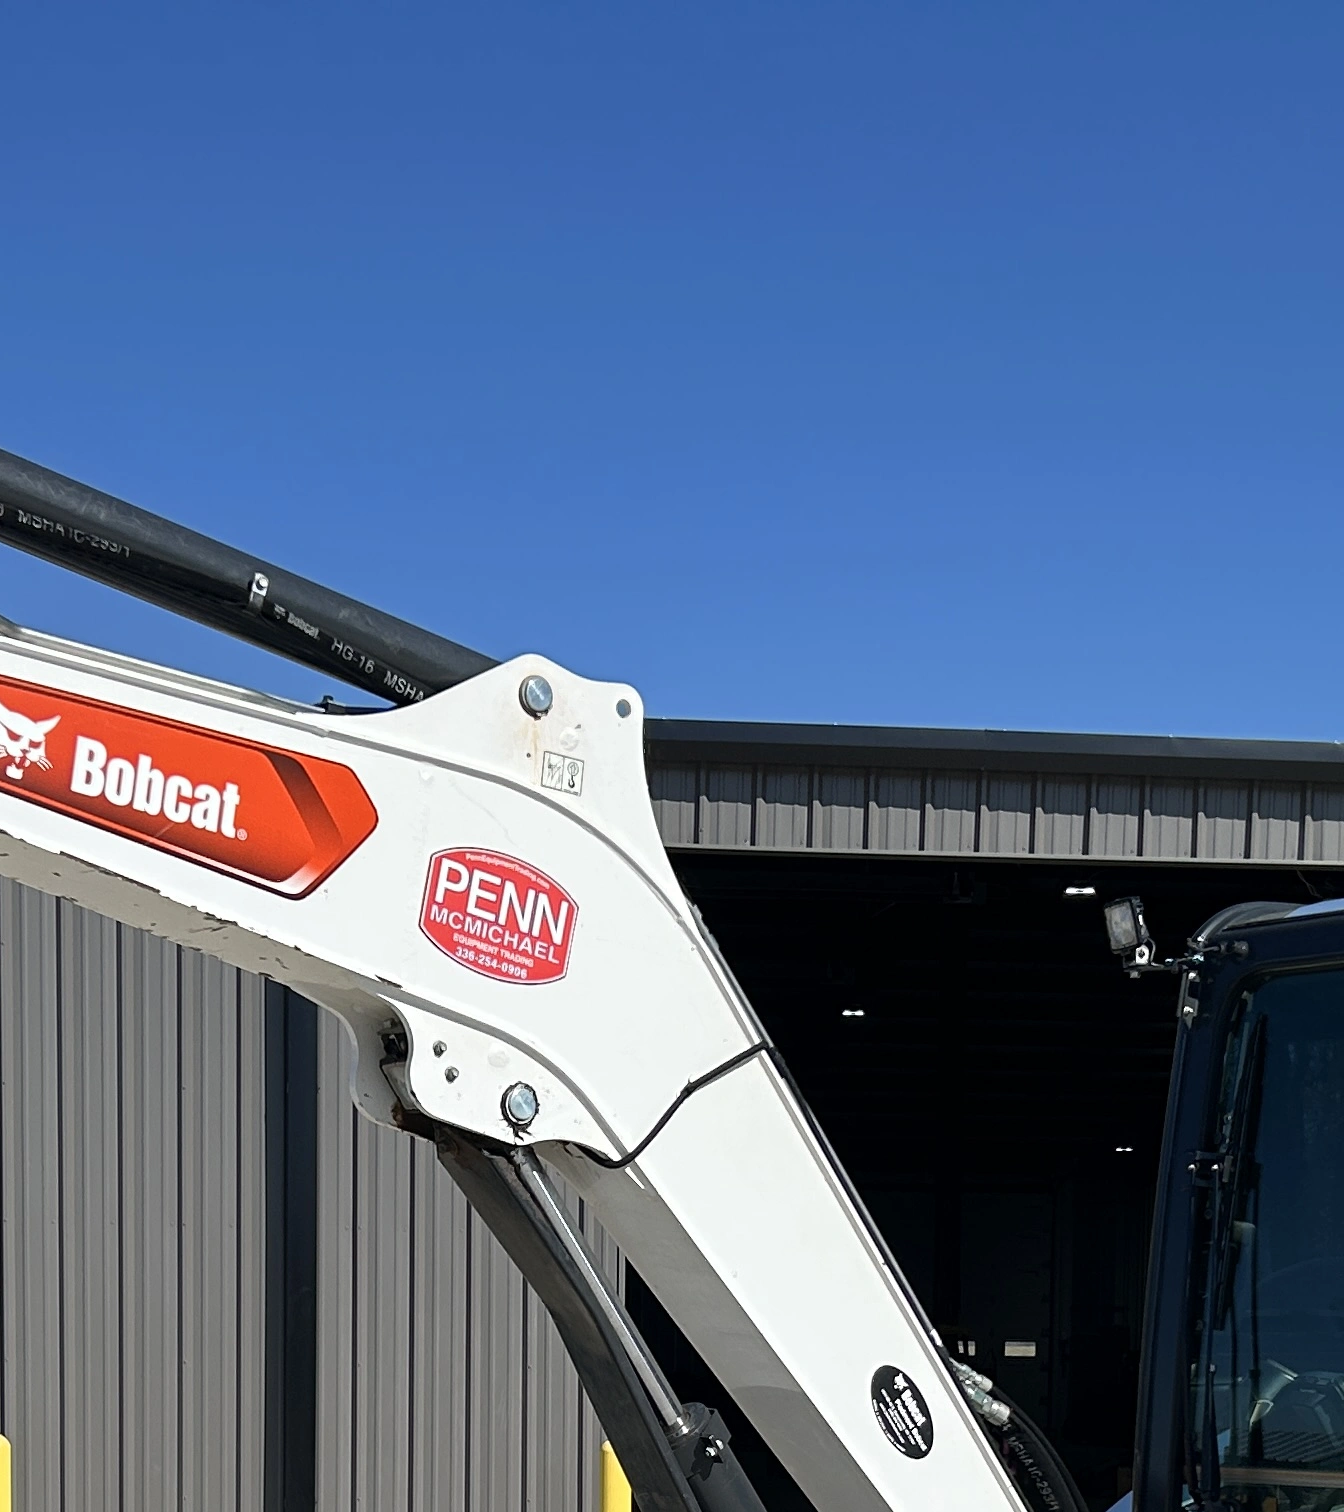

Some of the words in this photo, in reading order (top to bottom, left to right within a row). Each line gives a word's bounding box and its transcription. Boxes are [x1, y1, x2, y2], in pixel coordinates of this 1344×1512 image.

[330, 637, 376, 675] HG-16
[70, 735, 241, 840] Bobcat
[434, 857, 570, 946] PENN
[429, 903, 560, 965] MCMICHAEL
[452, 932, 499, 957] EQUIPMENT
[499, 947, 535, 968] TRADING
